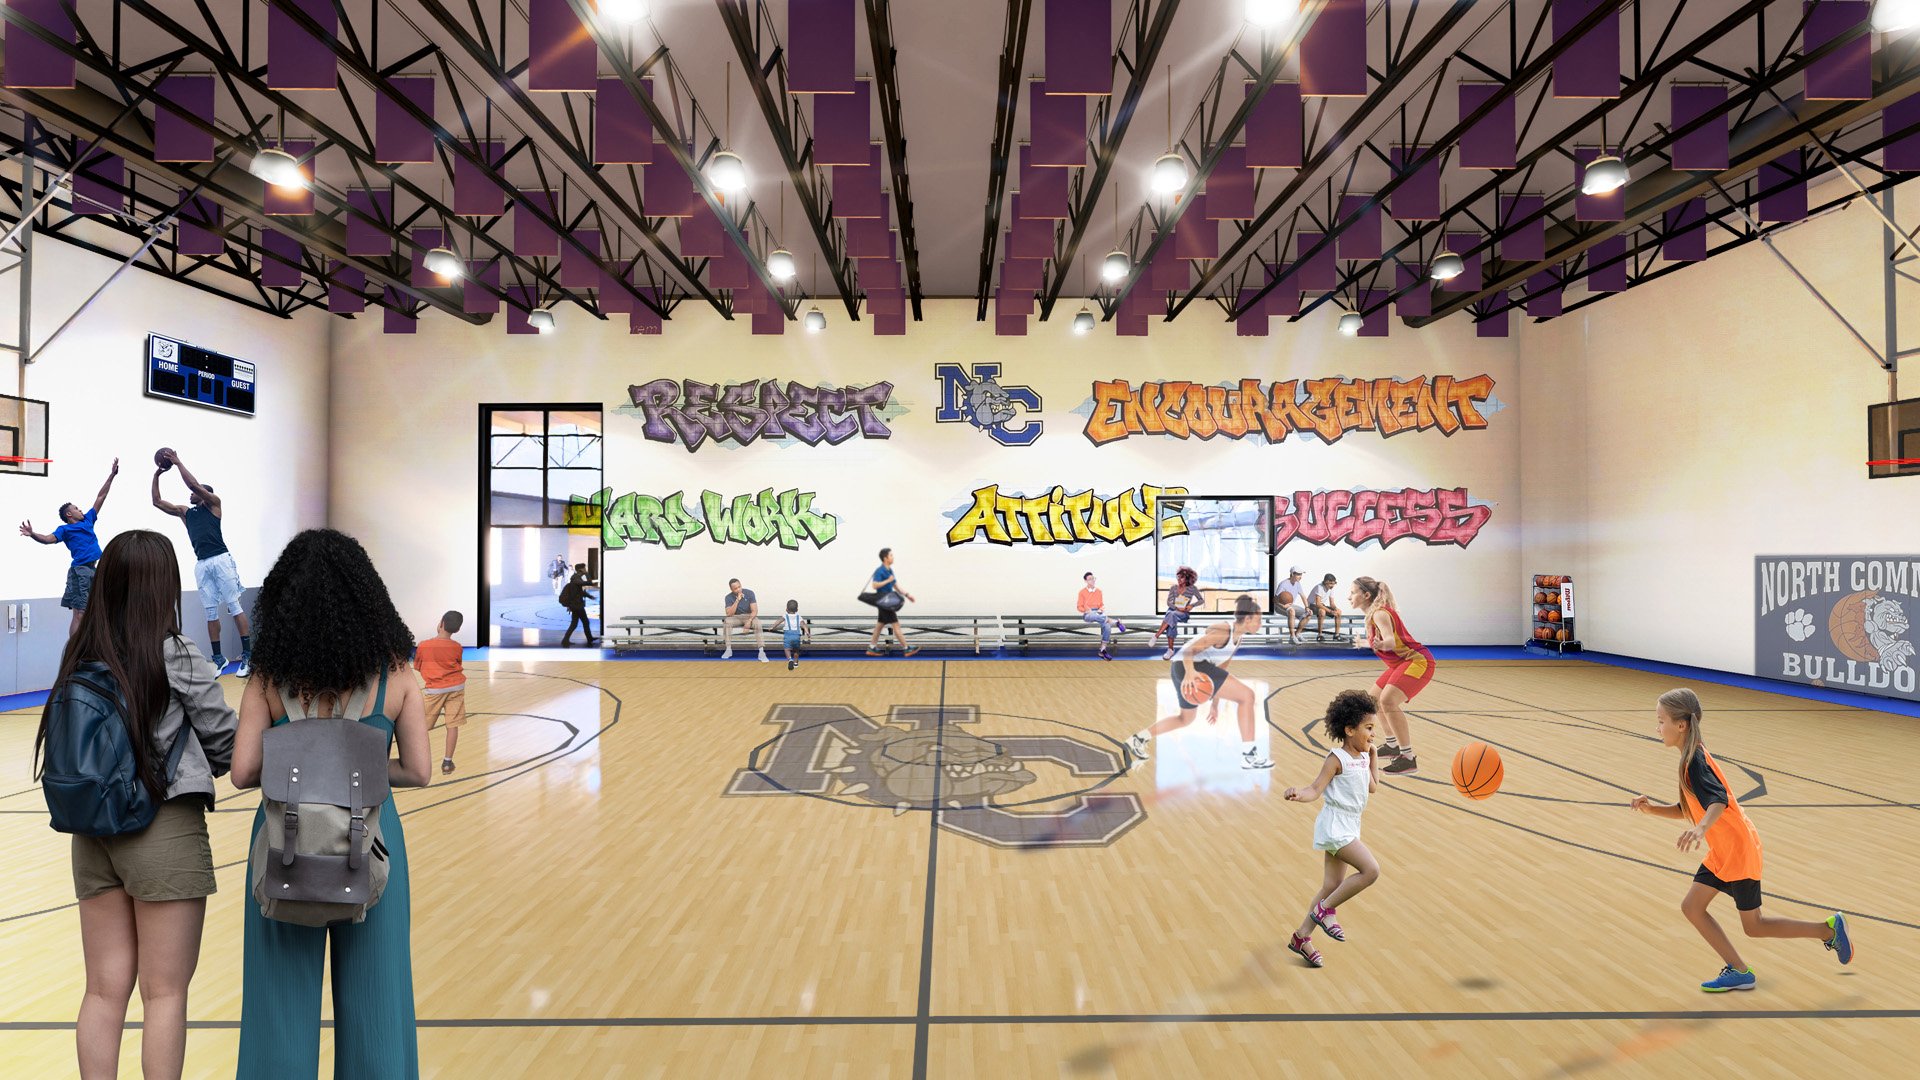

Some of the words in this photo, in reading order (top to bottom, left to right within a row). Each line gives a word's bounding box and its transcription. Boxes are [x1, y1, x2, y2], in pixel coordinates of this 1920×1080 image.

[158, 360, 179, 373] HOME
[197, 370, 216, 380] PERIOD
[231, 380, 250, 391] GUEST
[628, 378, 894, 453] RESPECT
[1082, 374, 1496, 447] ENCOURAGEMENT
[1761, 561, 1841, 617] NORTH
[1782, 652, 1920, 693] BULLDO
